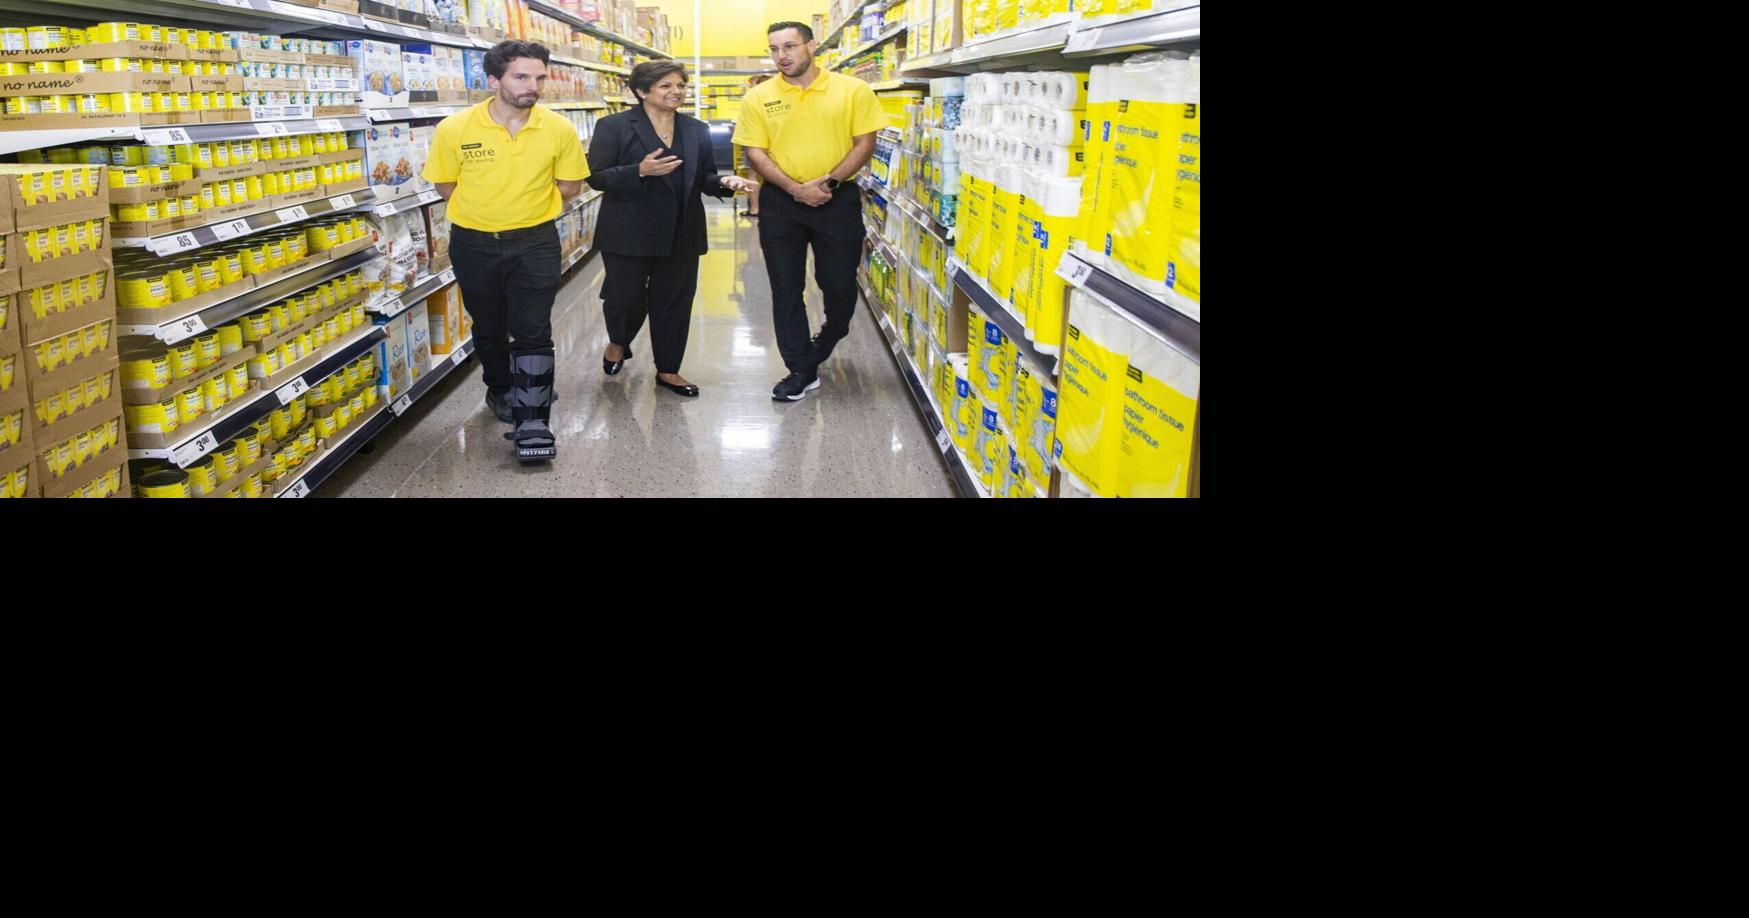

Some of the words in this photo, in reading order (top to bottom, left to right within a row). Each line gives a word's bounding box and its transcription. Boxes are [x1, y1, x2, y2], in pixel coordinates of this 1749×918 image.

[3, 82, 24, 91] no
[27, 79, 74, 90] name
[765, 104, 792, 115] store
[463, 148, 496, 159] store
[1049, 397, 1056, 408] 8
[1124, 385, 1158, 416] bathroom
[1158, 407, 1185, 432] tissue
